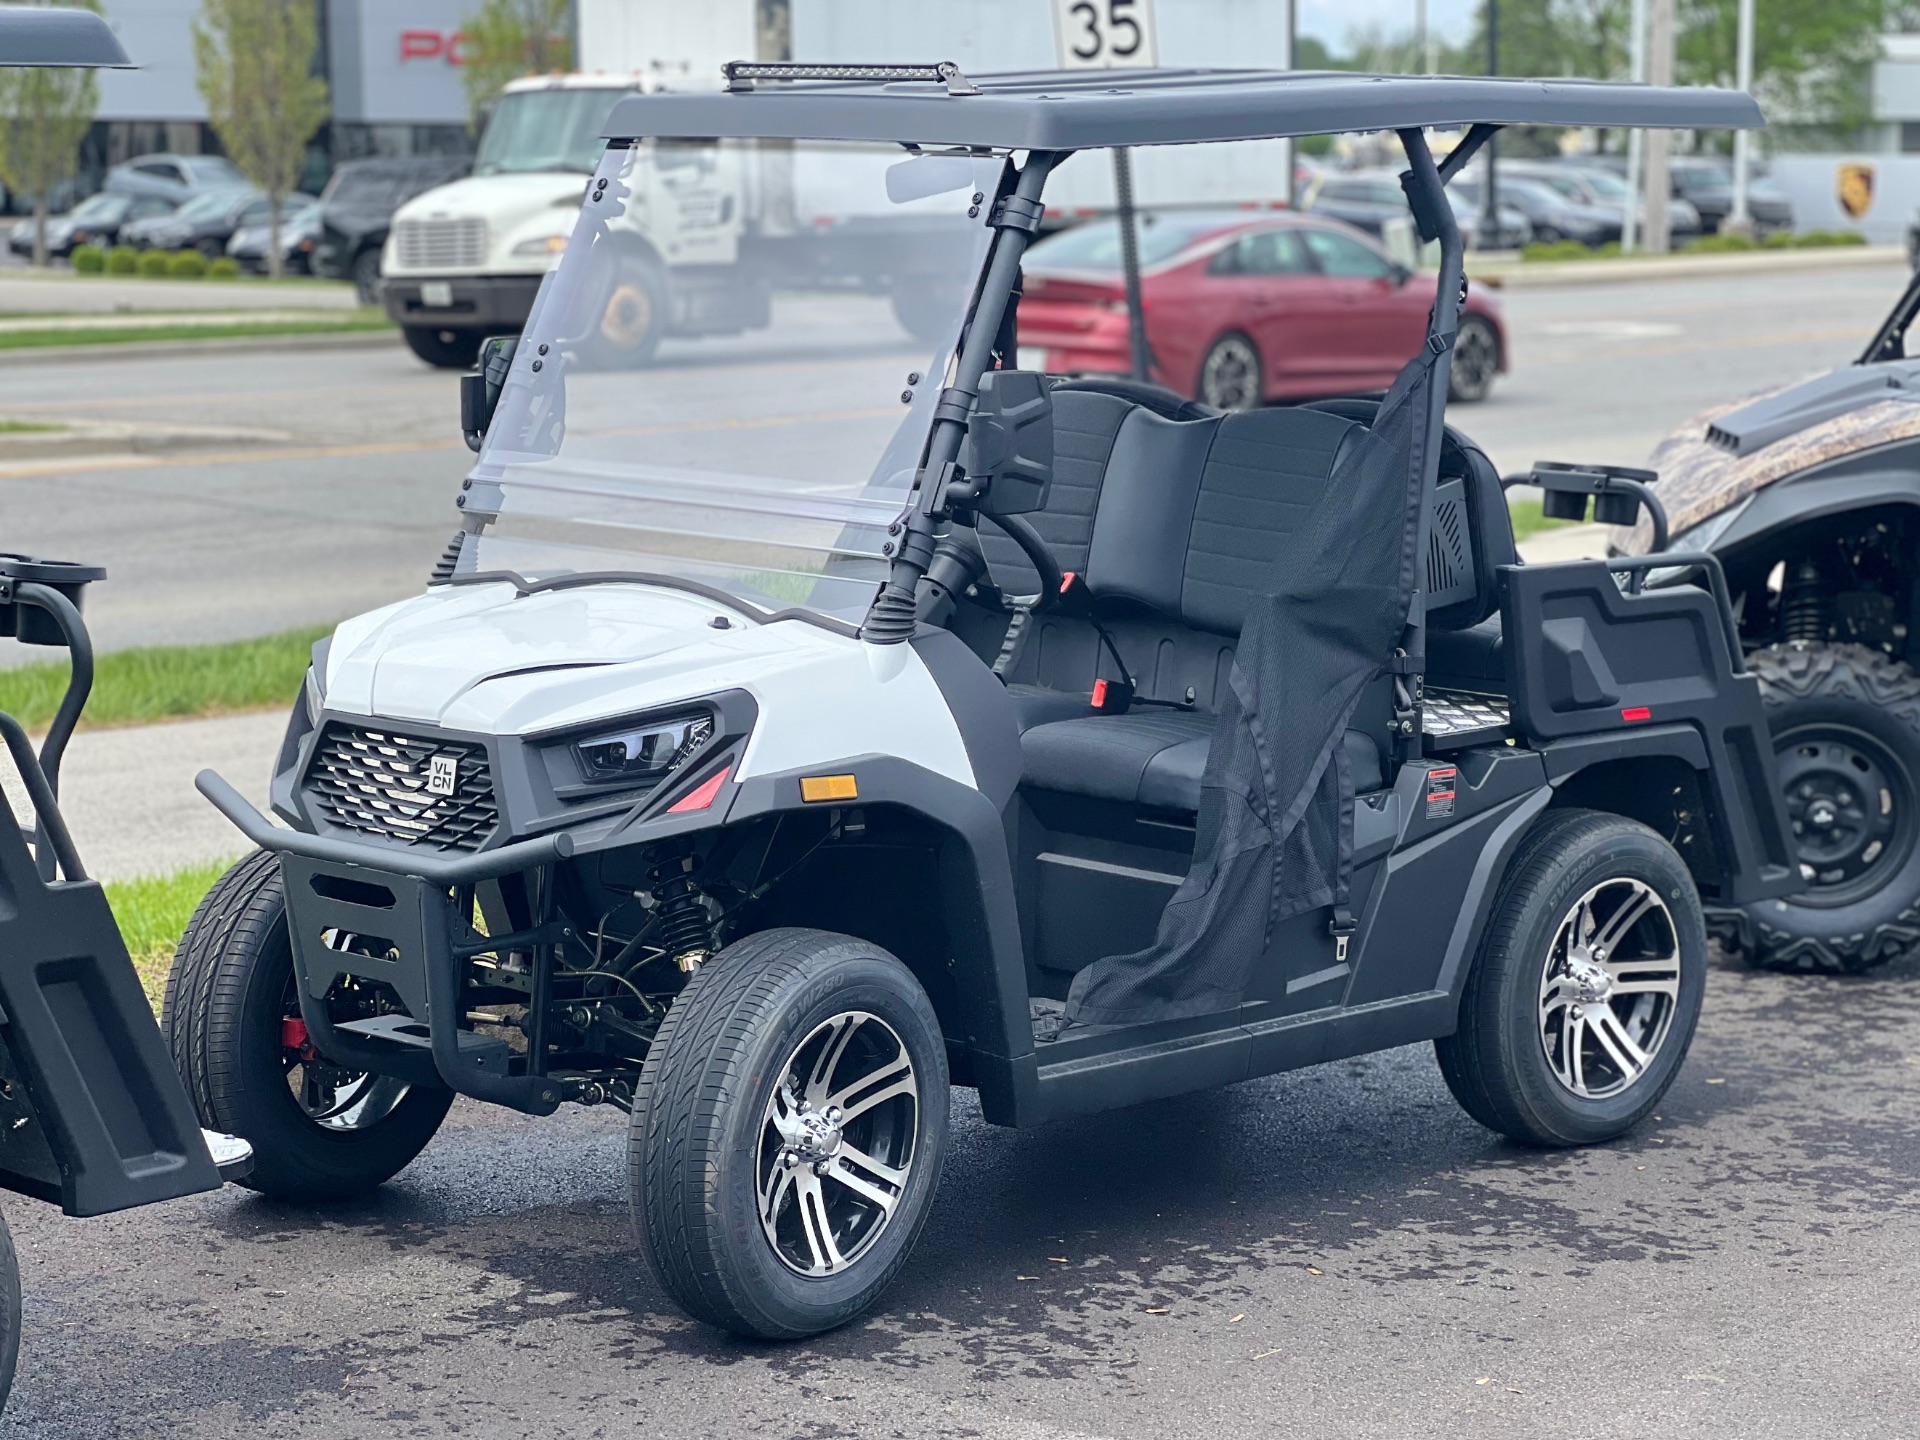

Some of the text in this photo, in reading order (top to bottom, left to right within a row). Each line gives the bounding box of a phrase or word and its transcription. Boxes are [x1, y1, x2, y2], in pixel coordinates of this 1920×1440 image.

[1070, 0, 1141, 59] 35
[432, 775, 452, 790] CN
[434, 761, 452, 776] VL
[1550, 854, 1597, 912] BW280
[787, 972, 846, 1030] BW280
